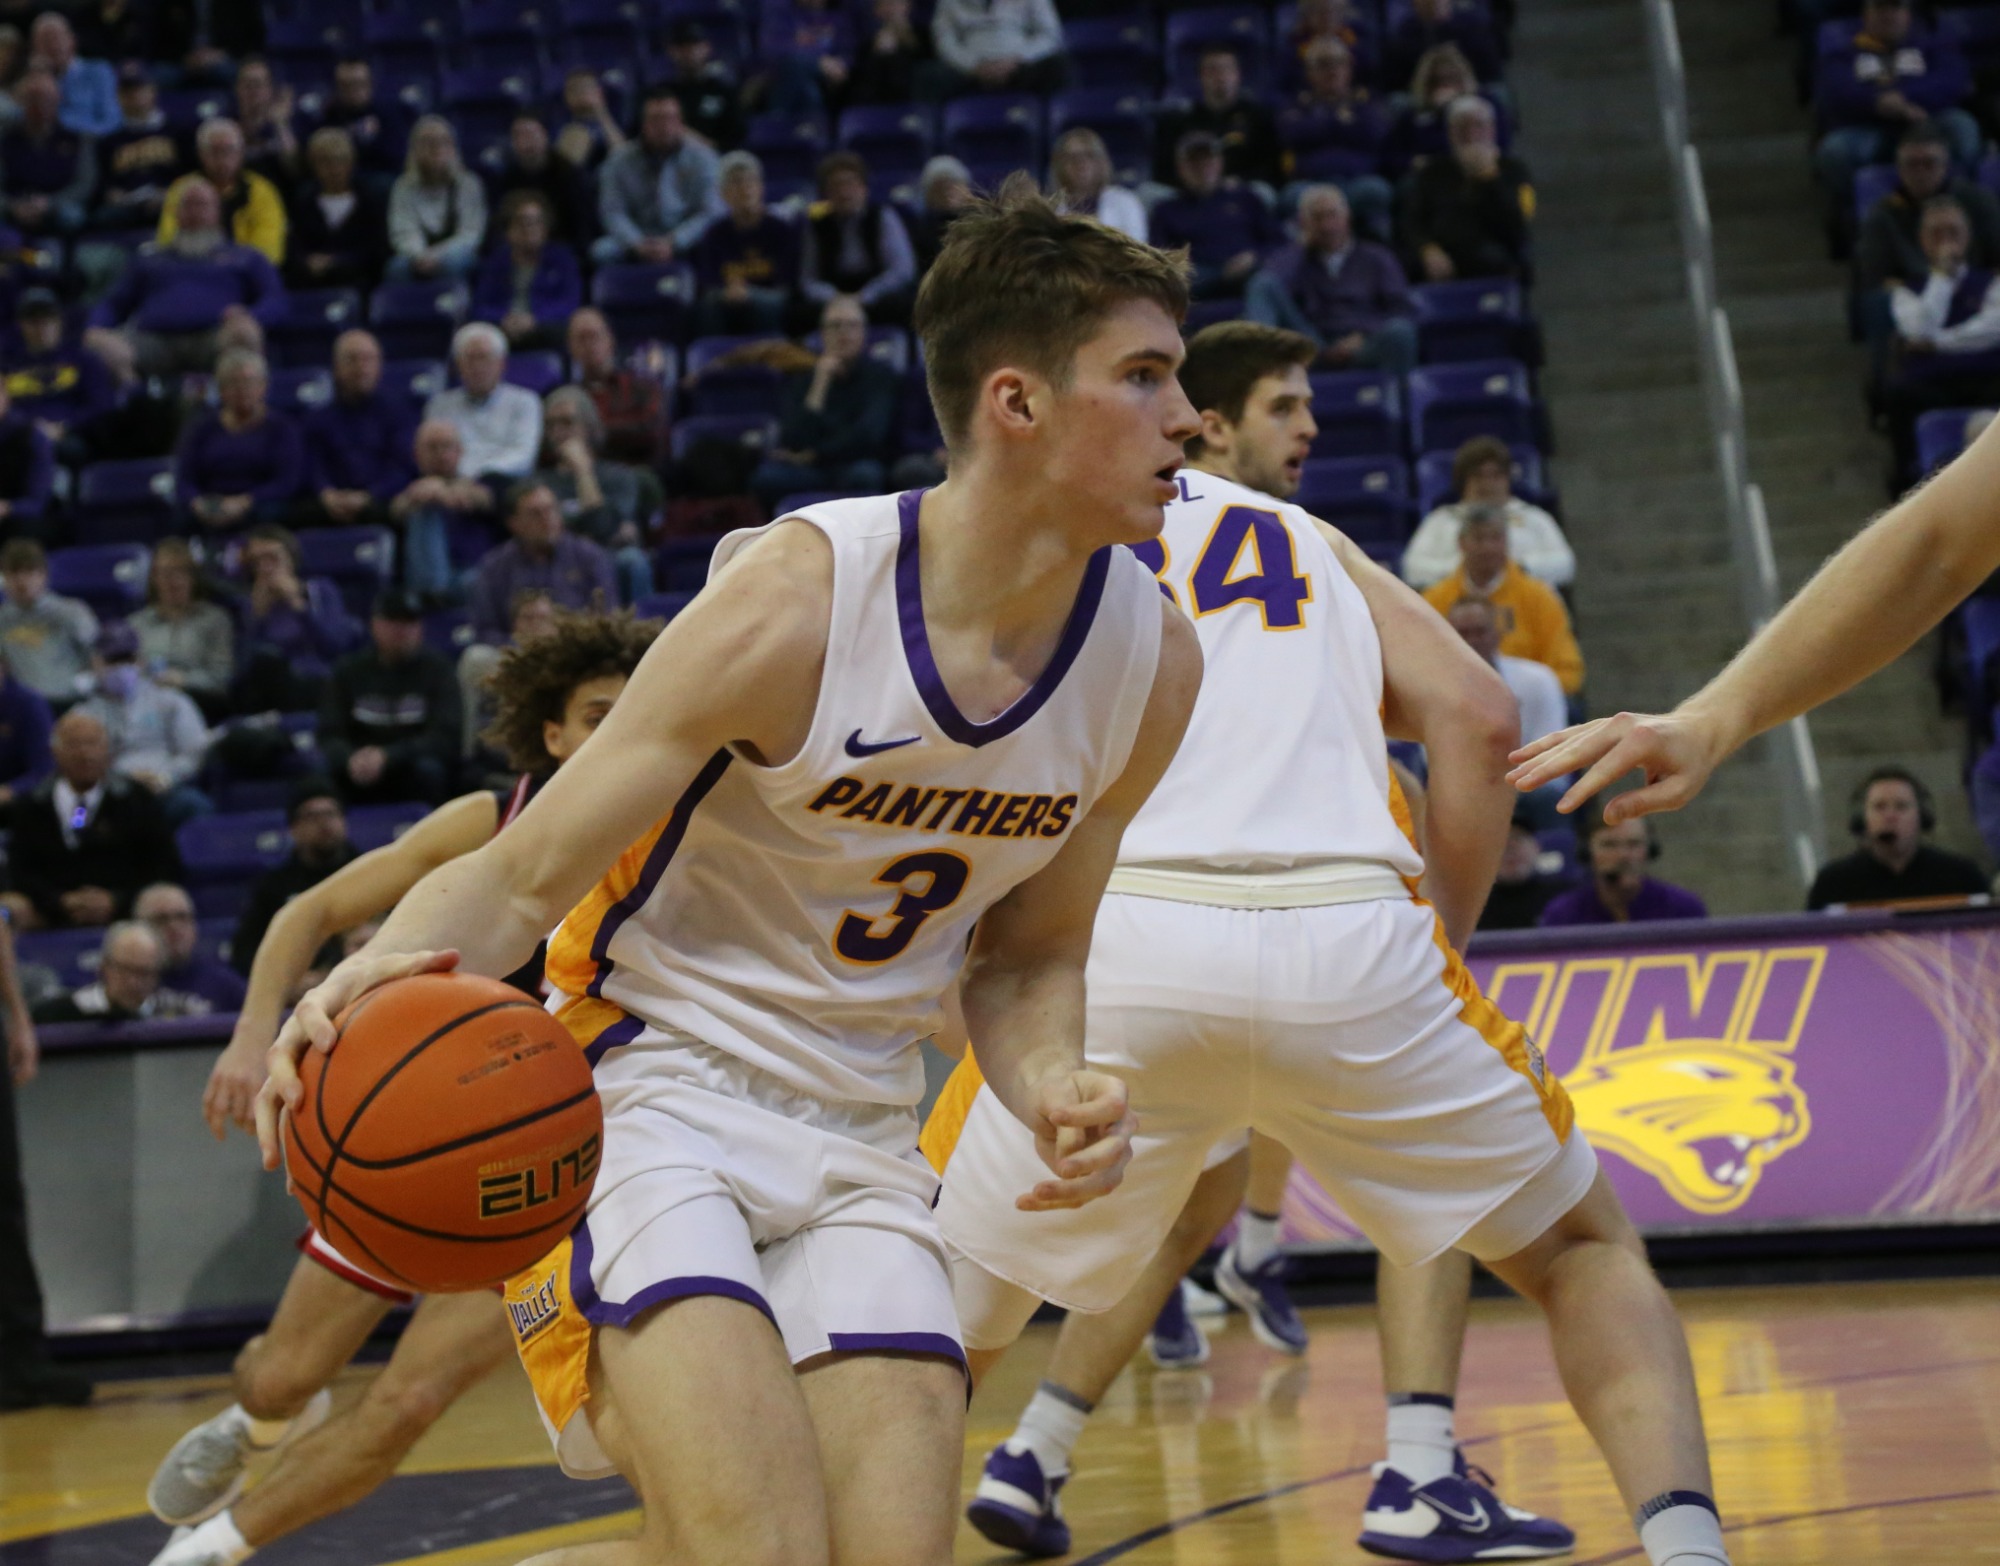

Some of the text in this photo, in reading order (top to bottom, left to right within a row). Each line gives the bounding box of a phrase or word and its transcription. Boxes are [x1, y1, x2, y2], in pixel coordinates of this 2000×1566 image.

[805, 774, 1079, 839] PANTHERS
[832, 847, 973, 966] 3
[479, 1131, 599, 1219] ELITE
[506, 1268, 560, 1335] VALLEY
